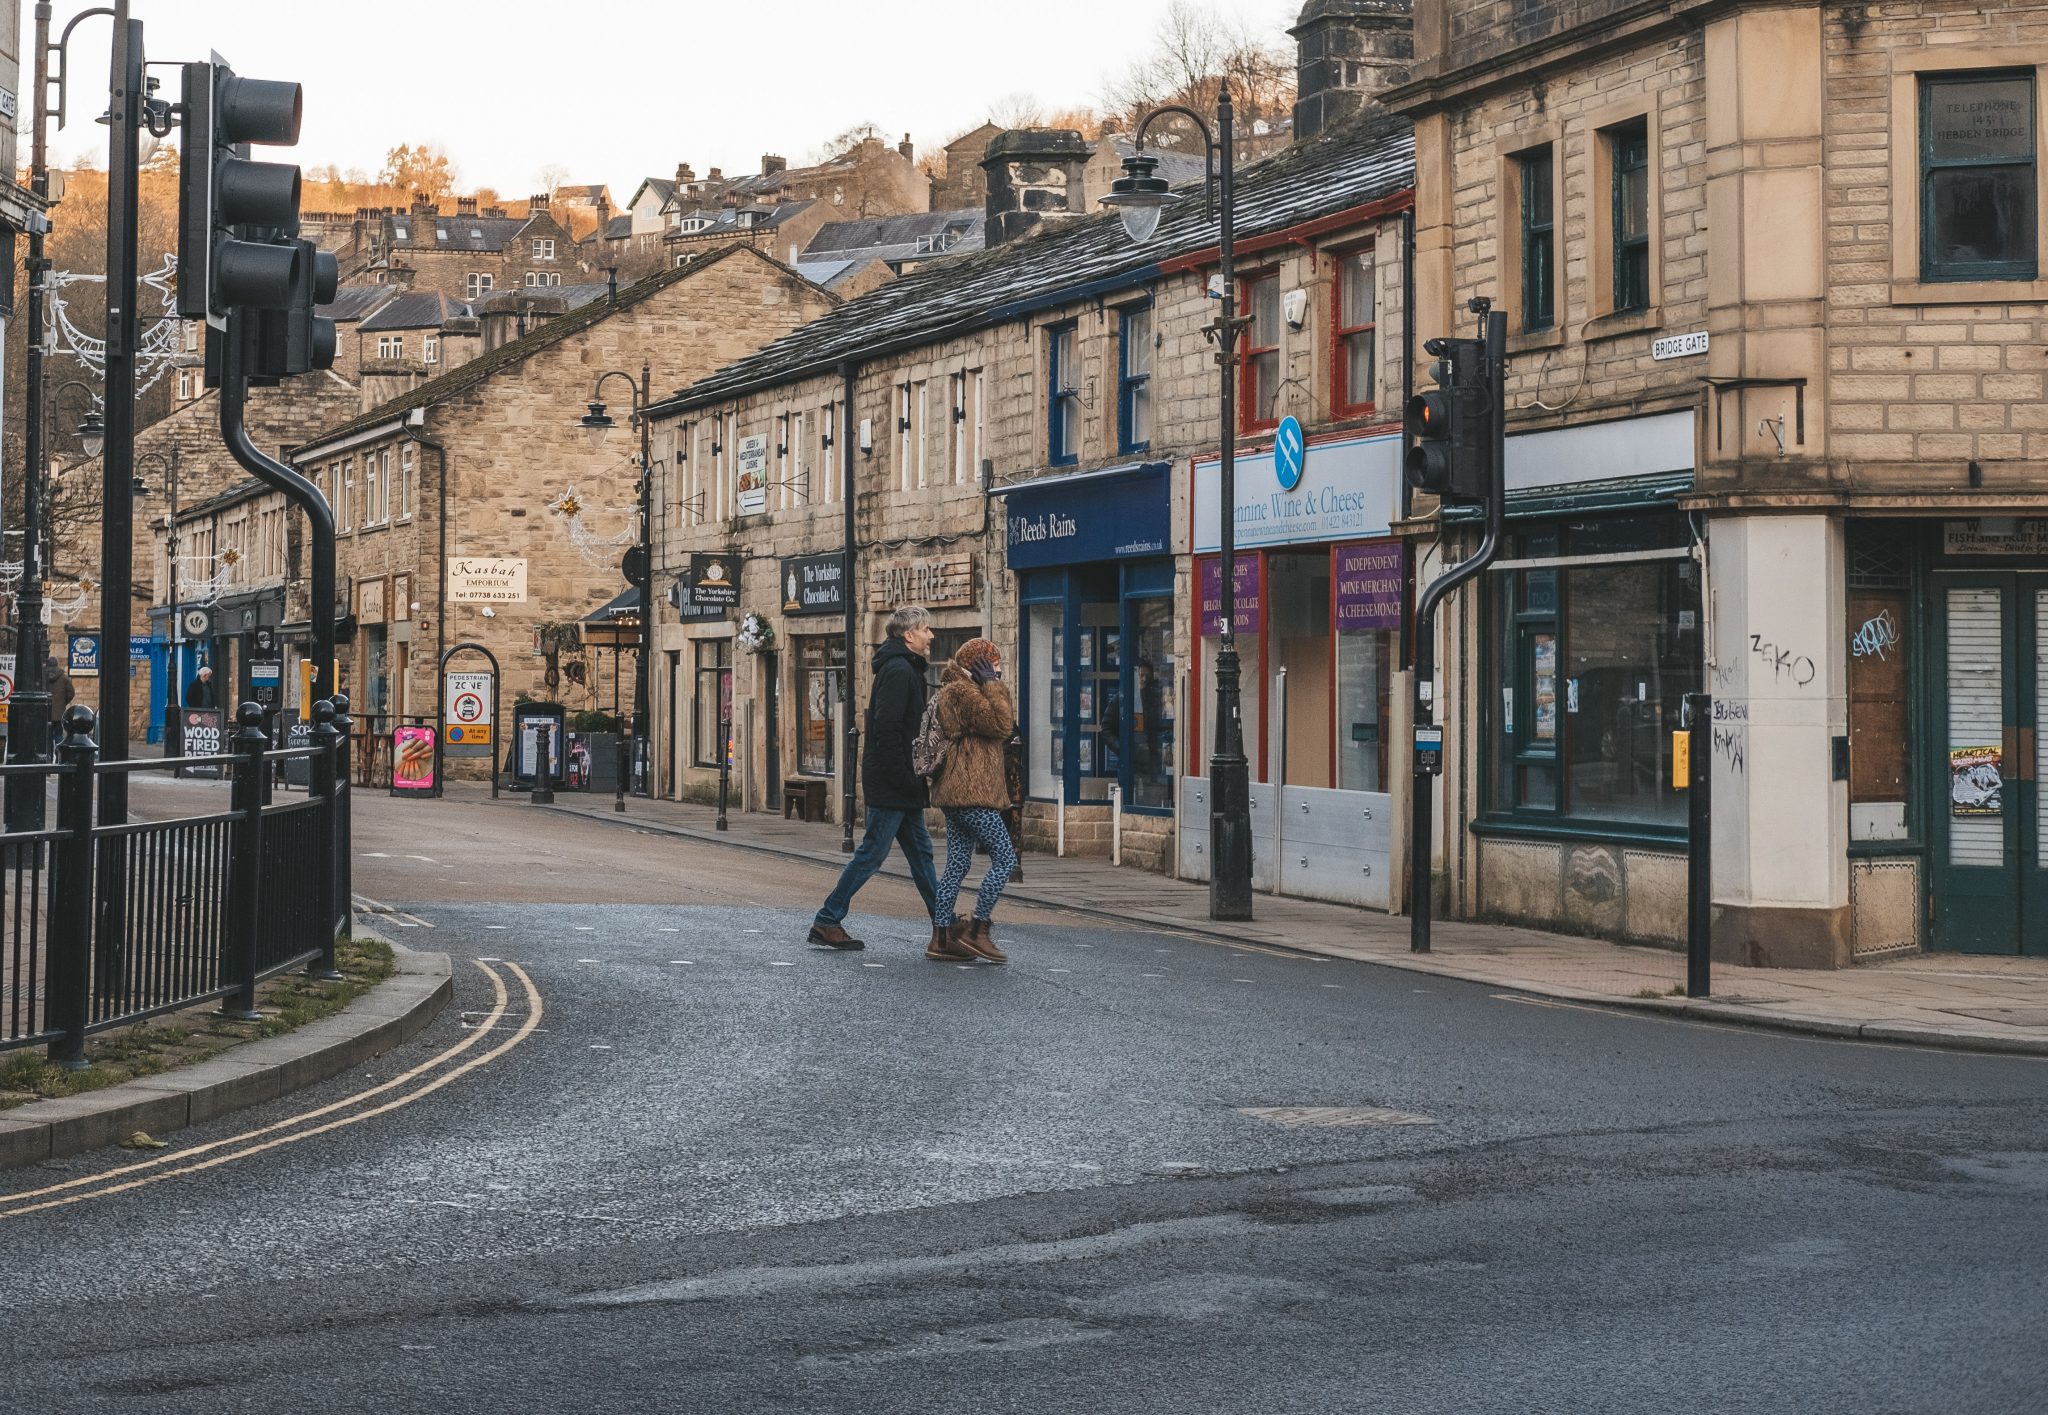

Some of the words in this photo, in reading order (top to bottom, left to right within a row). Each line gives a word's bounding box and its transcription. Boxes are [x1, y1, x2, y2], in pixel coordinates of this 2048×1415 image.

[1947, 101, 2017, 113] TELEPHONE
[1938, 129, 1982, 140] HEBDEN
[1985, 127, 2025, 138] BRIDGE
[1655, 339, 1682, 357] BRIDGE
[1686, 334, 1707, 351] GATE
[1233, 495, 1268, 523] ennine
[1271, 492, 1302, 519] Wine
[1305, 490, 1317, 516] &
[1321, 486, 1365, 514] Cheese
[1021, 515, 1047, 542] Reeds
[1050, 513, 1076, 539] Rains
[1948, 533, 1976, 543] FISH
[453, 560, 523, 577] Kasbah
[1345, 554, 1399, 571] INDEPENDENT
[804, 565, 815, 583] The
[815, 563, 840, 582] Yorkshire
[1214, 565, 1248, 578] SACHES
[466, 579, 509, 587] EMPORIUM
[885, 567, 910, 605] BAY
[912, 562, 946, 601] TREE
[1341, 581, 1360, 595] WINE
[1361, 578, 1402, 594] MERCHANT
[695, 587, 706, 595] The
[708, 587, 737, 596] Yorkshire
[804, 586, 830, 604] Chocolate
[831, 585, 840, 602] Co.
[1234, 597, 1259, 609] OCOLATE
[1339, 605, 1345, 618] &
[1346, 601, 1402, 617] CHEESEMONGE
[1234, 615, 1249, 625] OODS
[72, 652, 96, 664] Food
[0, 663, 13, 671] NE
[184, 726, 220, 739] WOOD
[184, 739, 220, 751] FIRED
[1953, 747, 1999, 758] HEARTICAL
